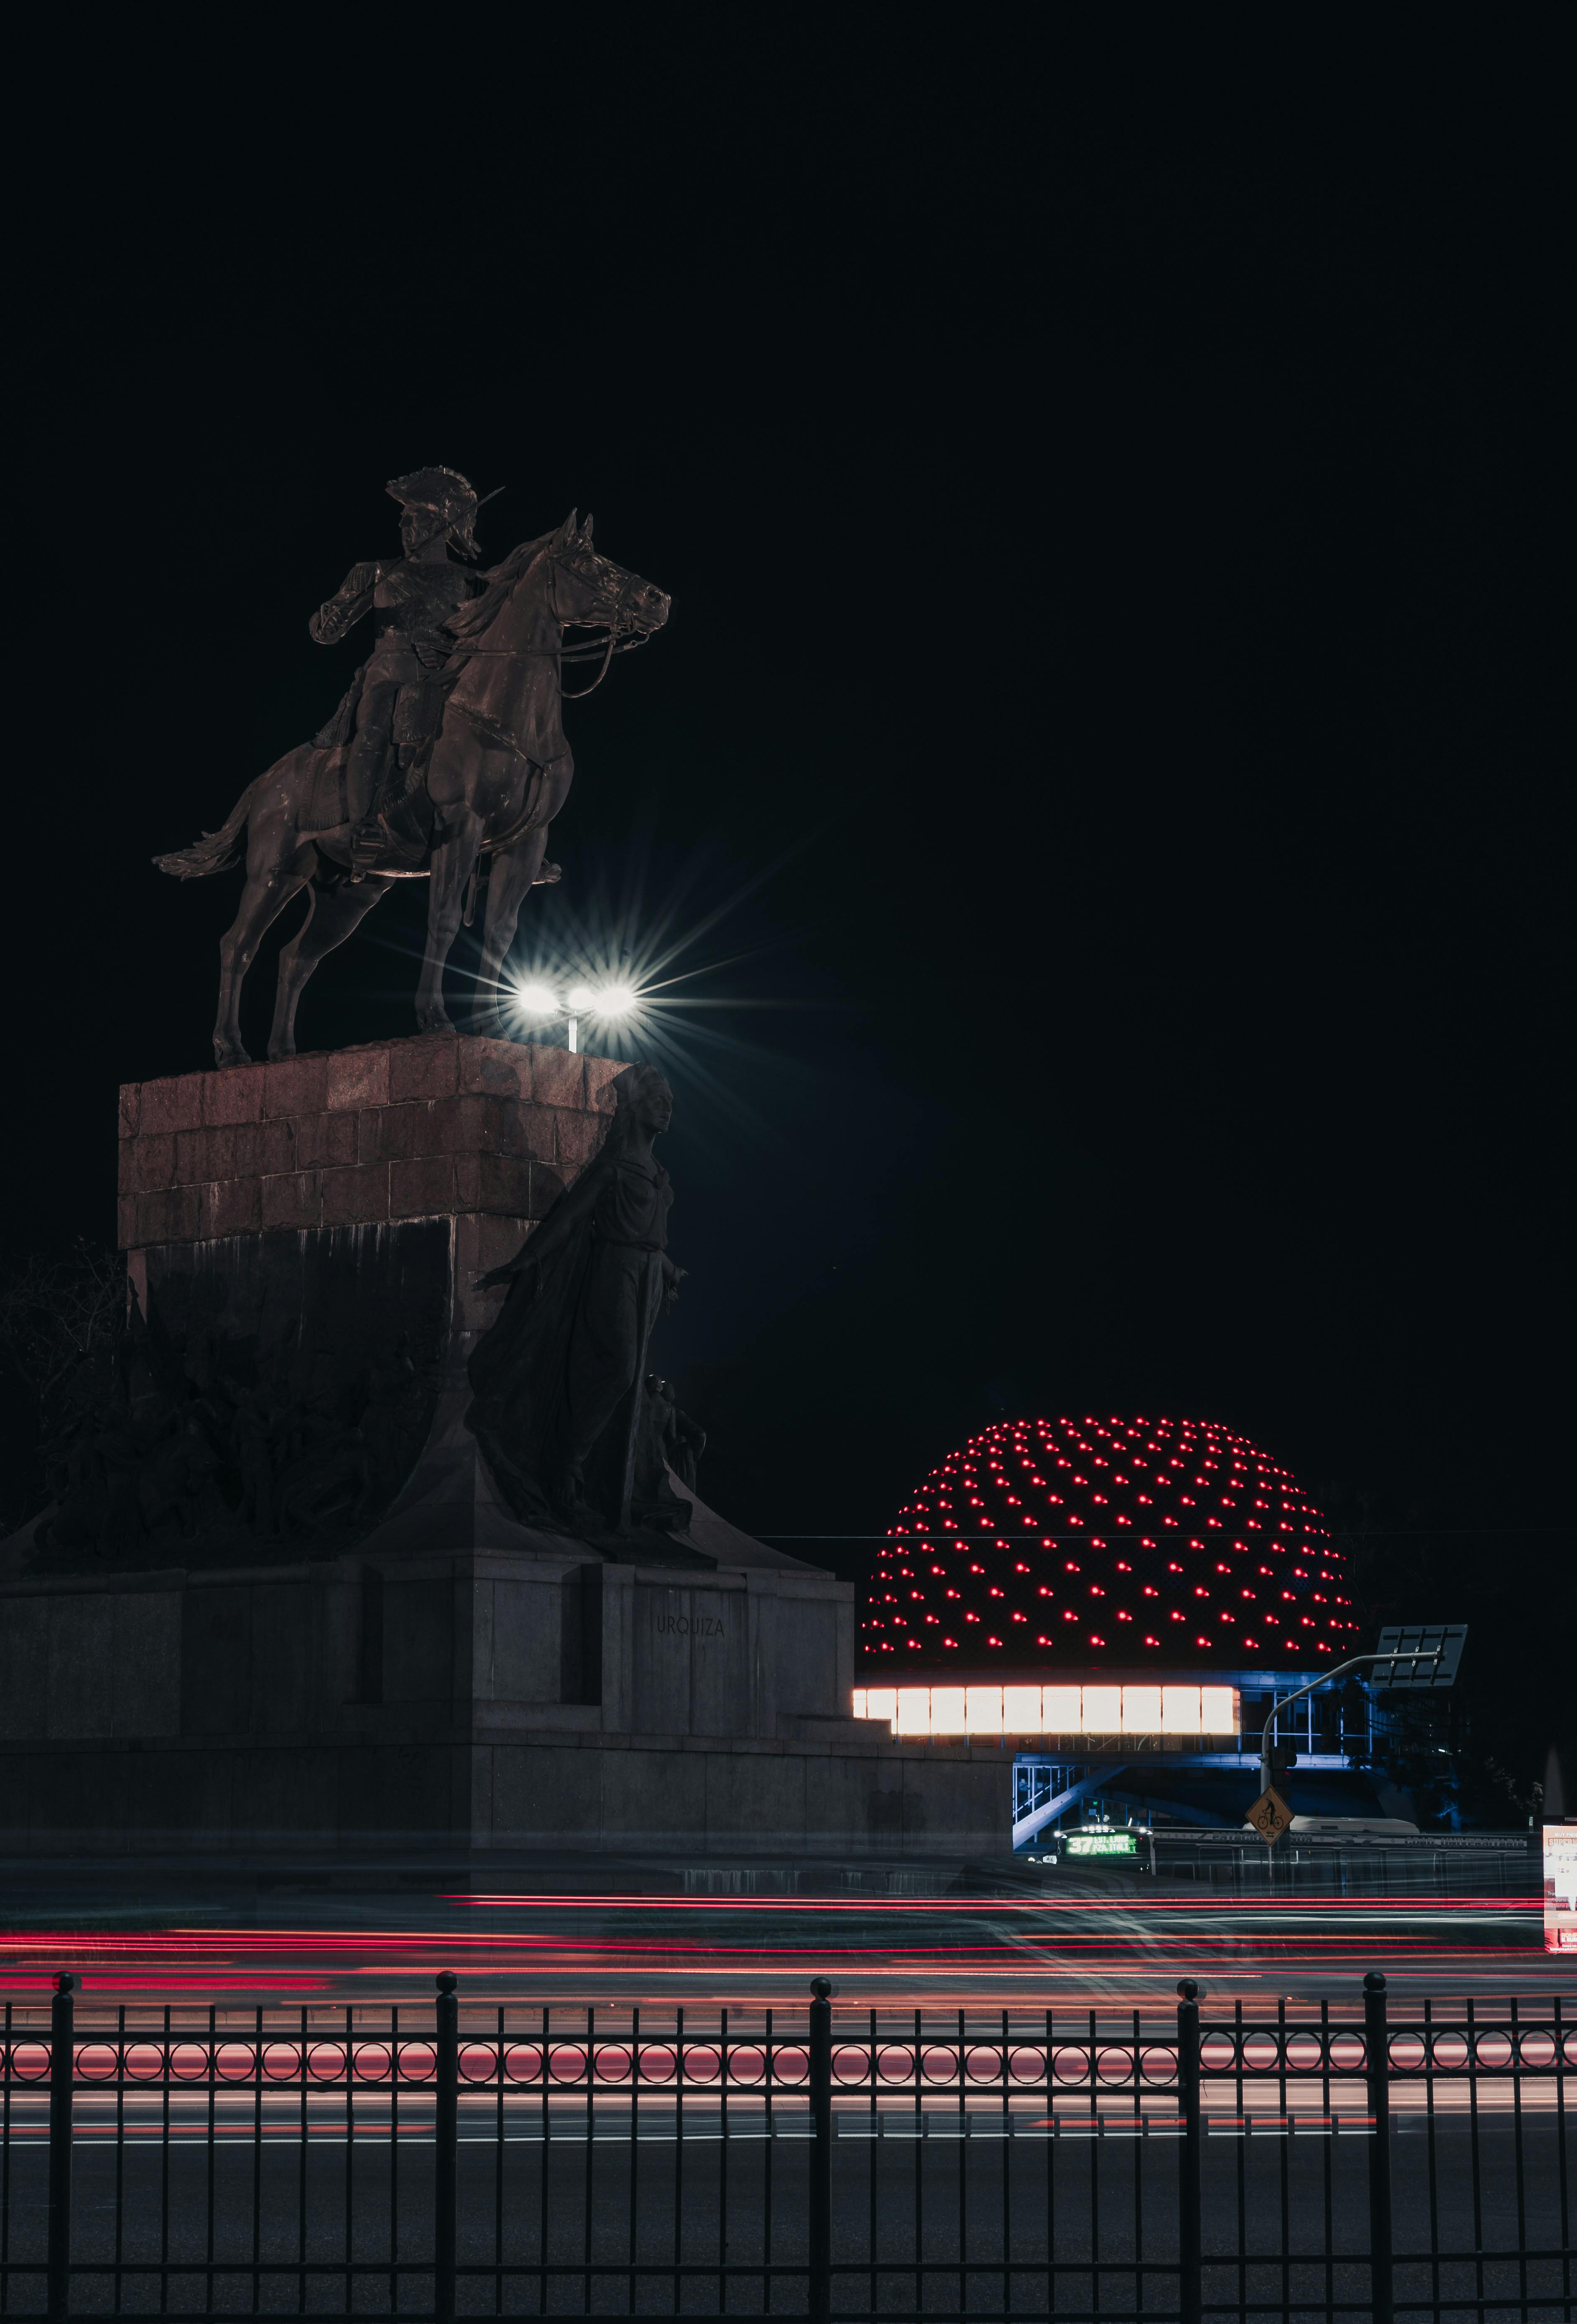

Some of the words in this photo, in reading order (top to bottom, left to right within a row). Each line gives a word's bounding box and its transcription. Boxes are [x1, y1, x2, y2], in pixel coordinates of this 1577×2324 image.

[657, 1616, 724, 1637] URQUIZA
[1069, 1837, 1093, 1853] 37
[1212, 1832, 1265, 1843] ESTACIO
[1441, 1837, 1524, 1849] UNIVERSITARIA
